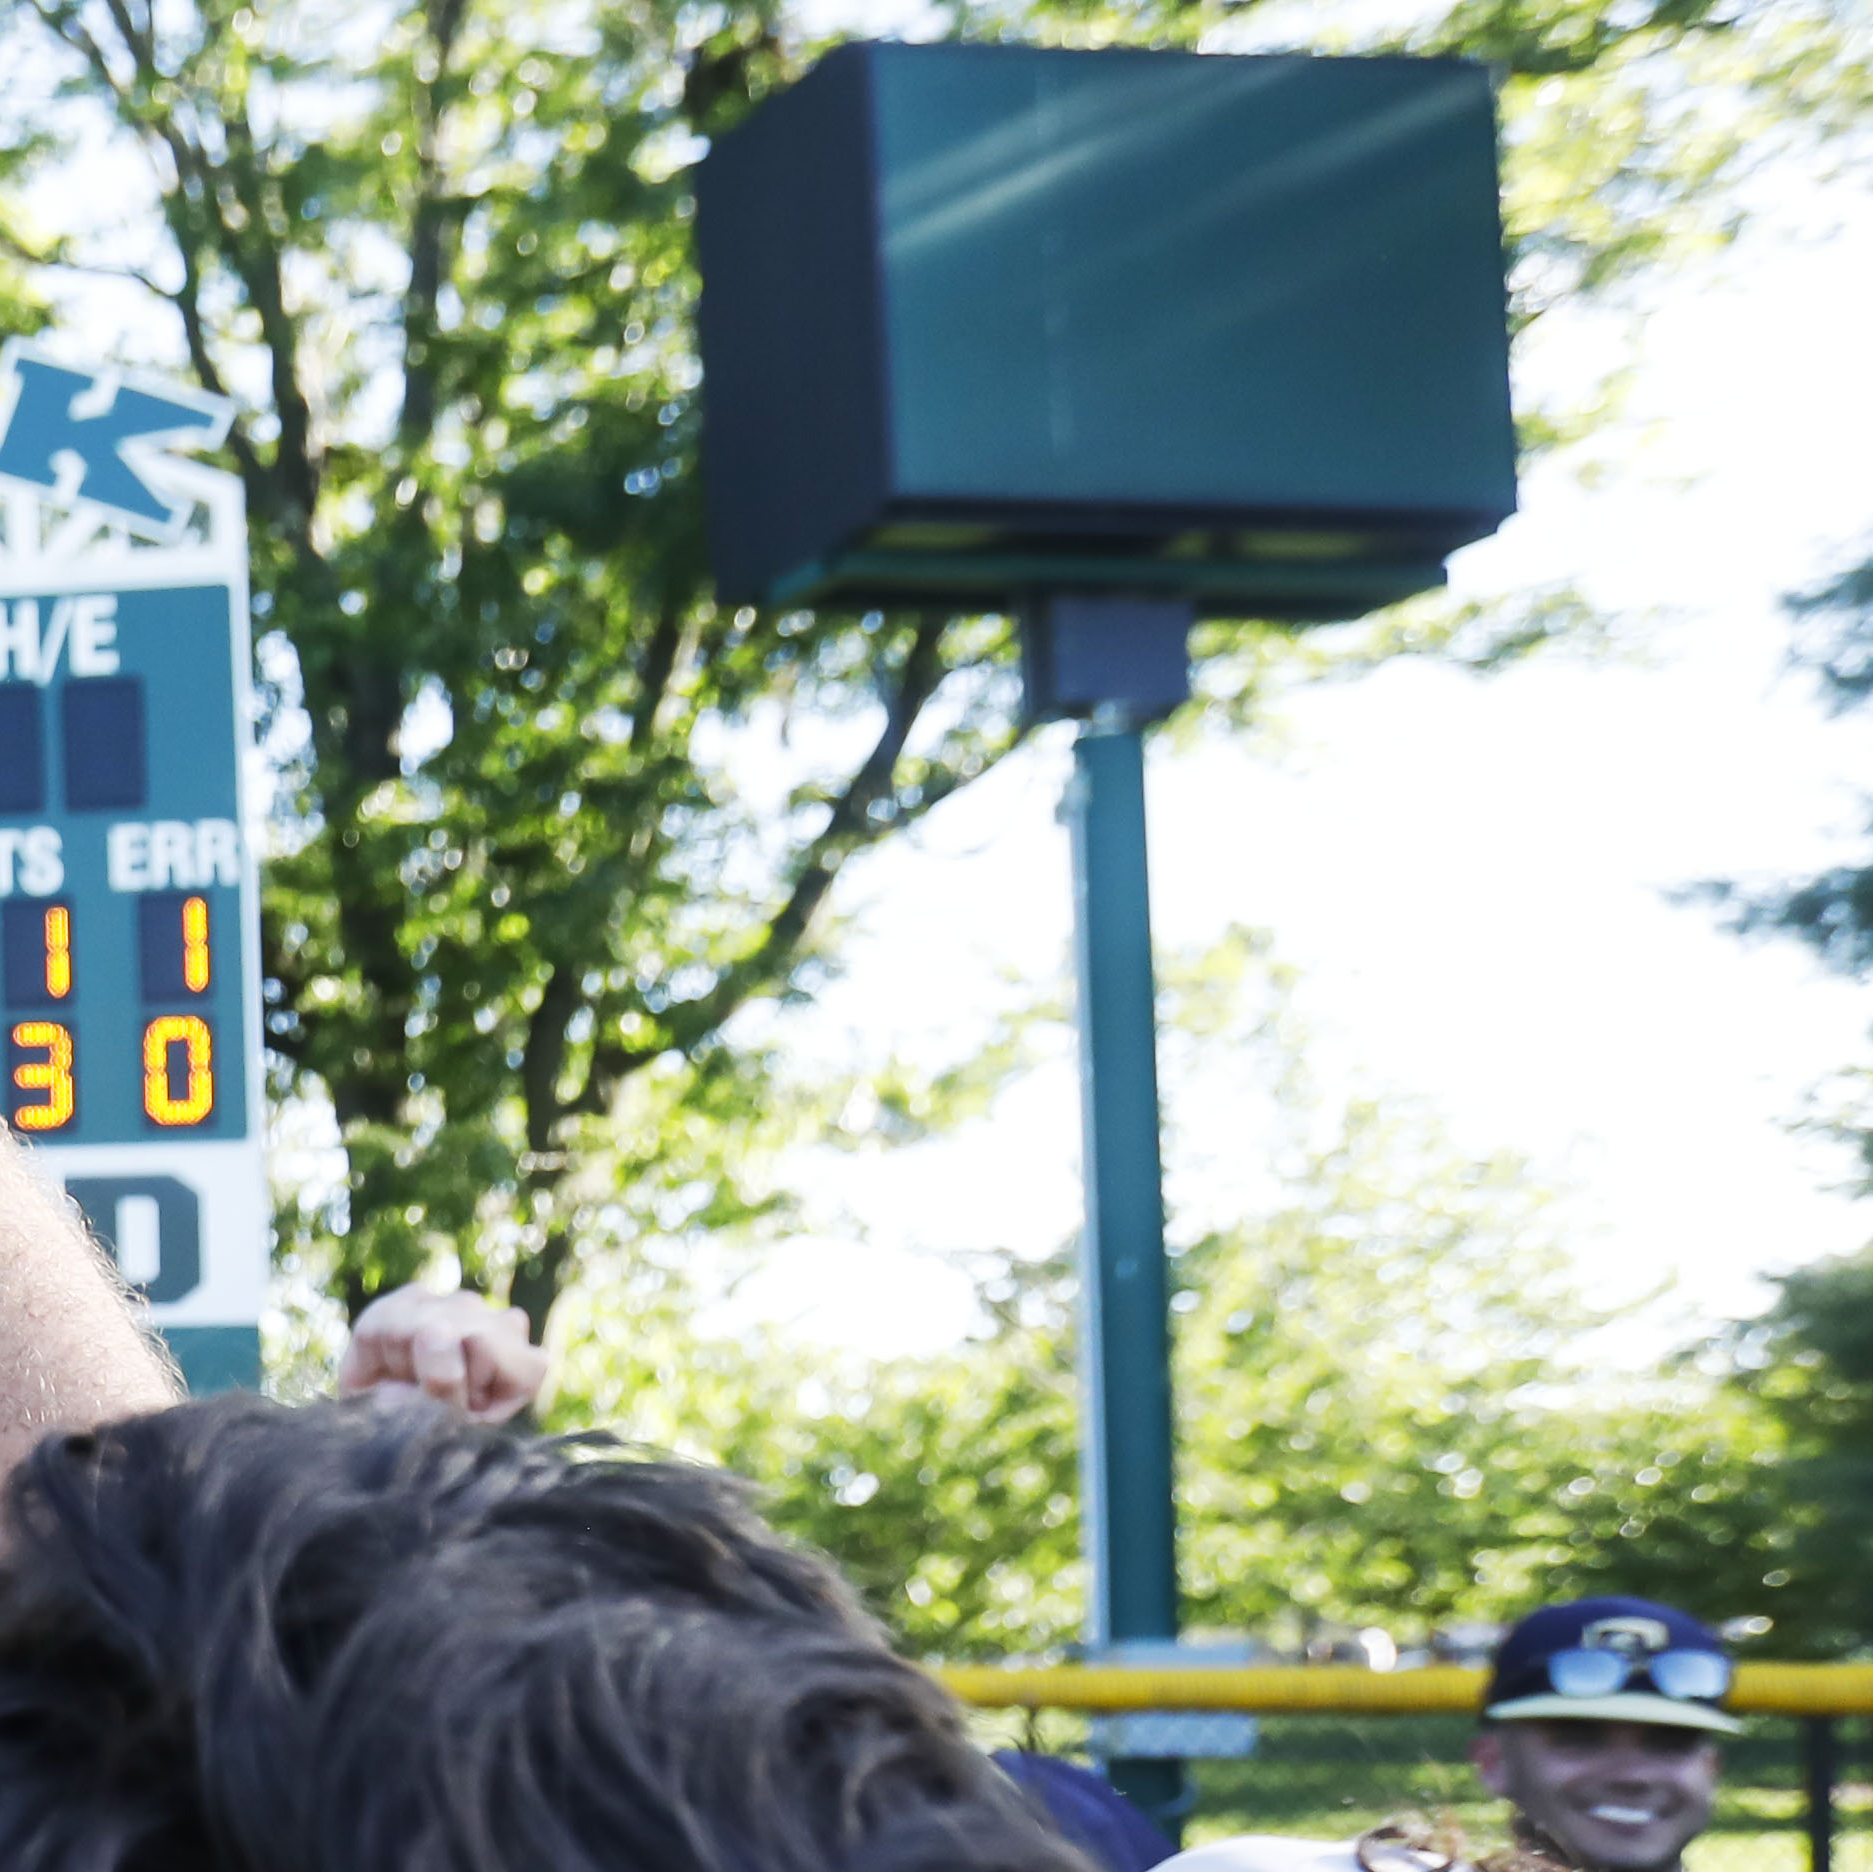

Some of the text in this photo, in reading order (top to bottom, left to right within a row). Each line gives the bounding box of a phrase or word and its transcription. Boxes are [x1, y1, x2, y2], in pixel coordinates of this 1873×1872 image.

[108, 819, 240, 892] ERR
[183, 896, 210, 992] 1
[12, 1015, 213, 1131] 3 0
